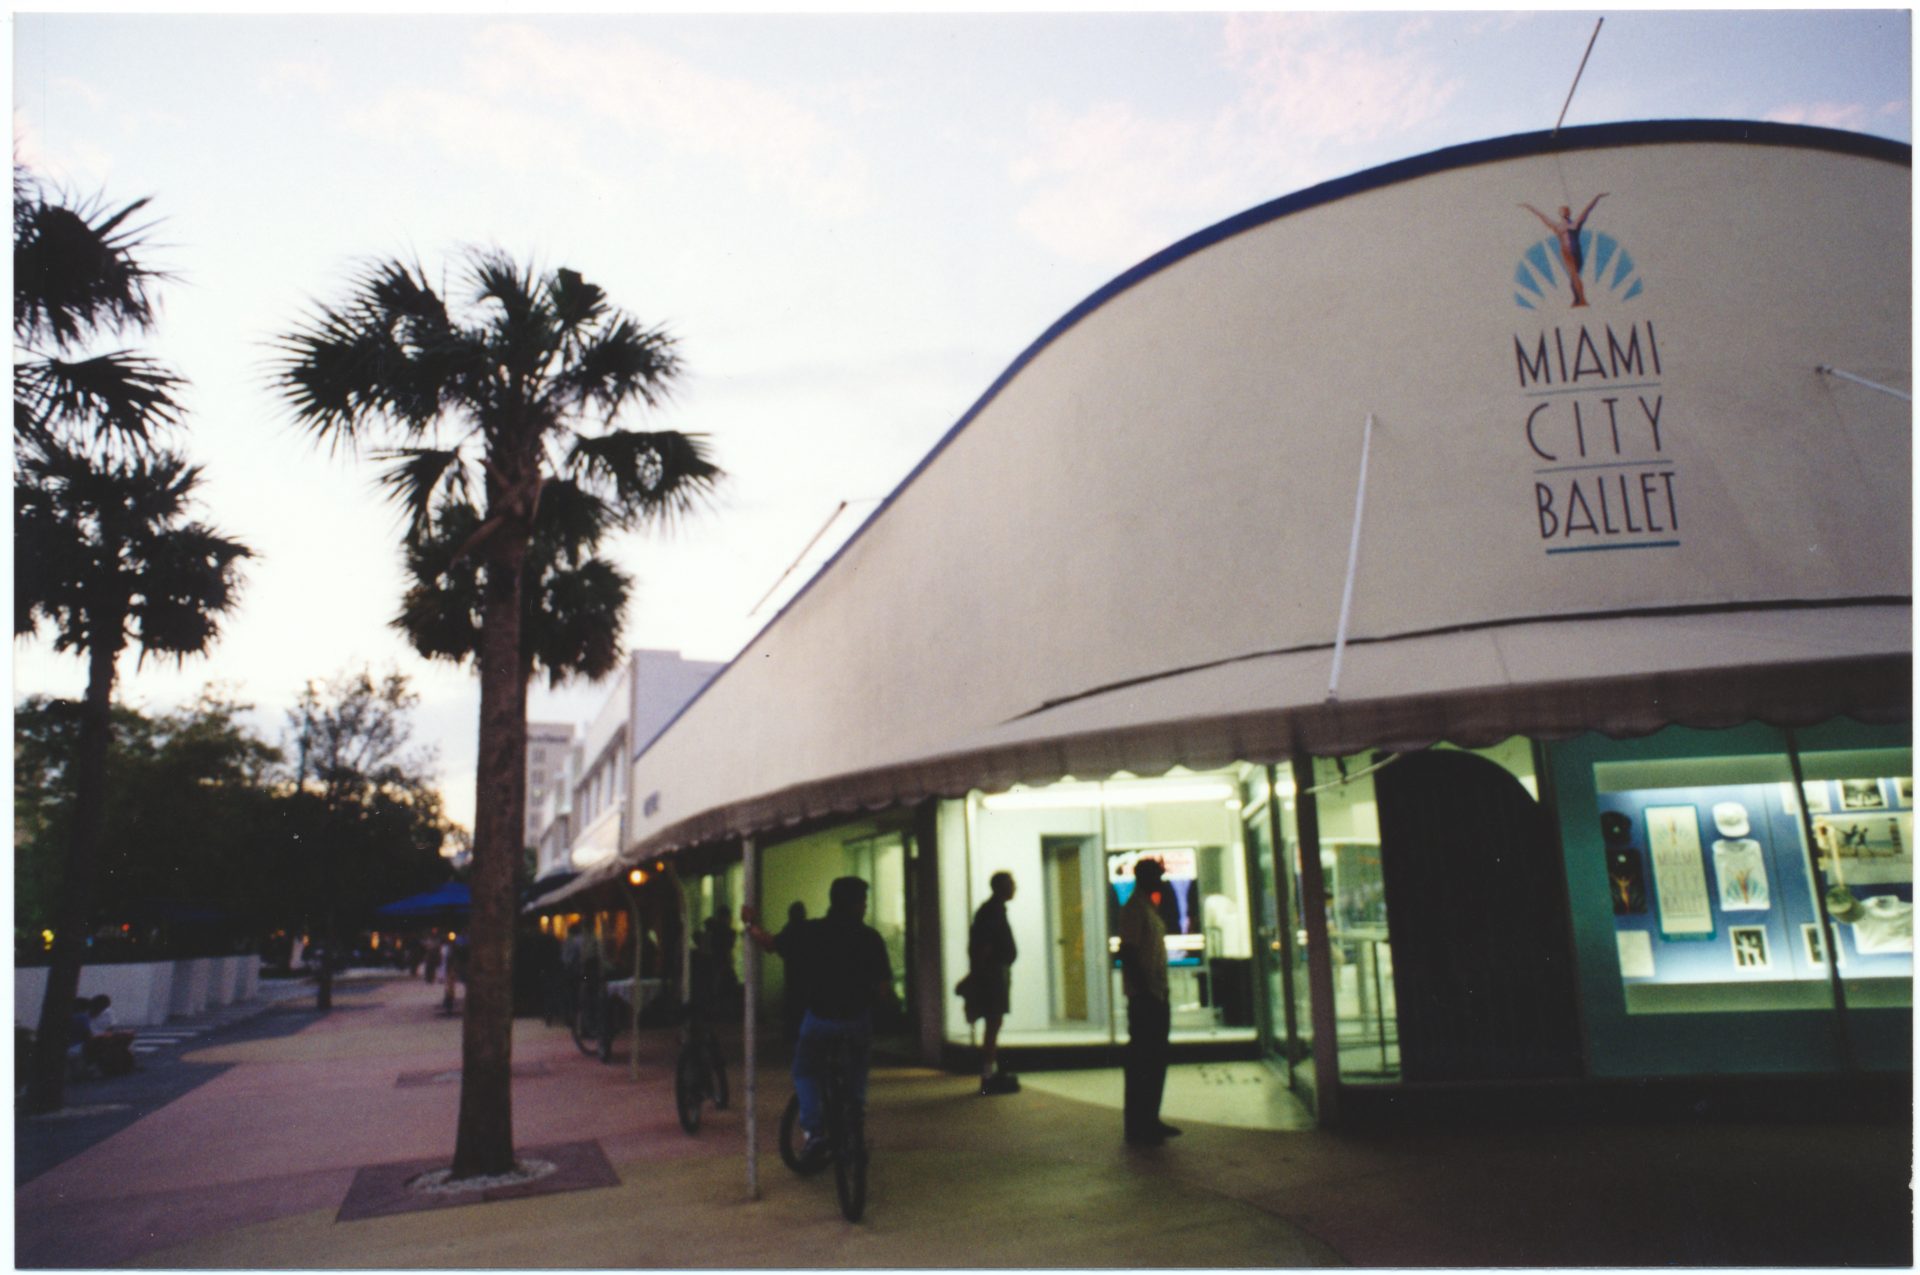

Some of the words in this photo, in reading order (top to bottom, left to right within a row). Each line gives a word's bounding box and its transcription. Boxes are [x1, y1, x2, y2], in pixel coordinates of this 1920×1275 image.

[1514, 320, 1661, 388] MIAMI
[1526, 395, 1662, 461] CITY
[1535, 471, 1678, 539] BALLET
